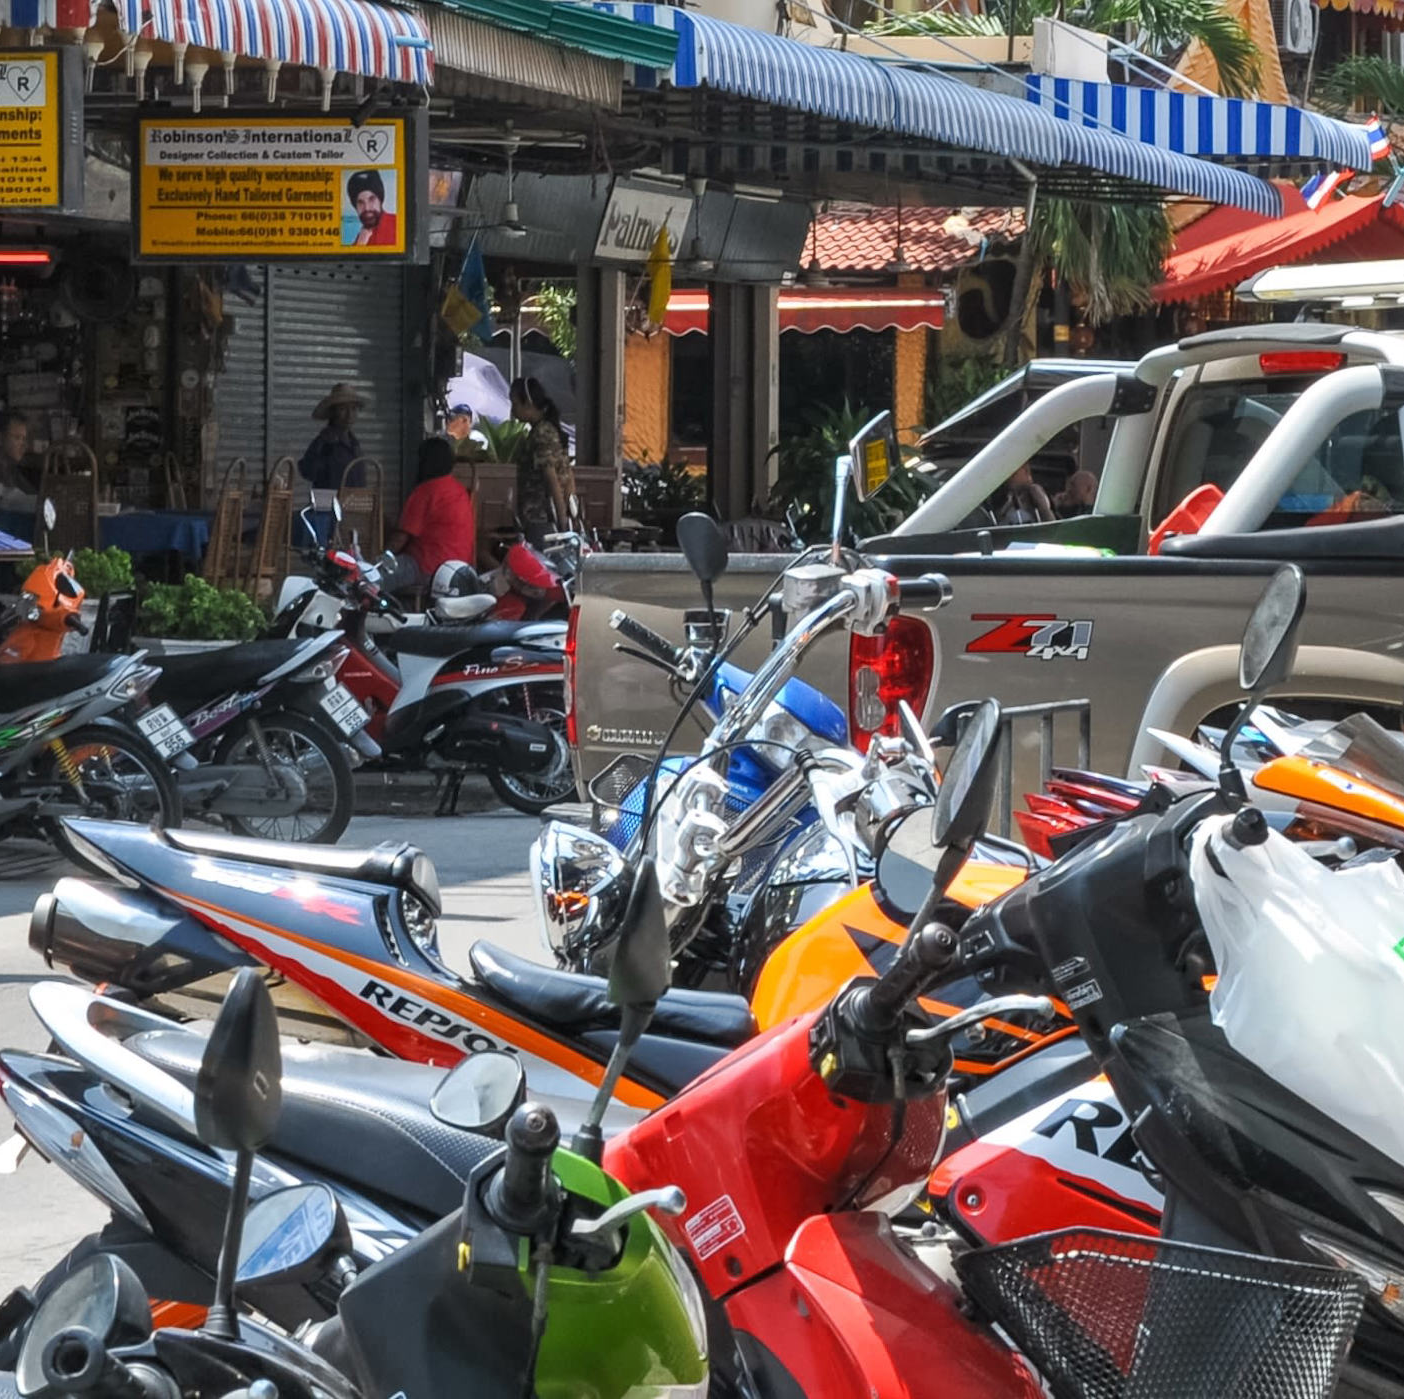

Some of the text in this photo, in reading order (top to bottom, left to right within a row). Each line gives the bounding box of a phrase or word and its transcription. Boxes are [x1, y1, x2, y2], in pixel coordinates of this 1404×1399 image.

[16, 77, 29, 92] R
[367, 140, 377, 152] R
[159, 151, 204, 162] Designer
[207, 150, 258, 160] Collection
[273, 150, 311, 160] Custom
[315, 150, 344, 160] Tailor
[158, 170, 174, 182] We
[176, 171, 203, 182] serve
[206, 169, 227, 184] high
[229, 169, 262, 185] quality
[157, 188, 333, 205] Exclusively Hand Tailored Garments
